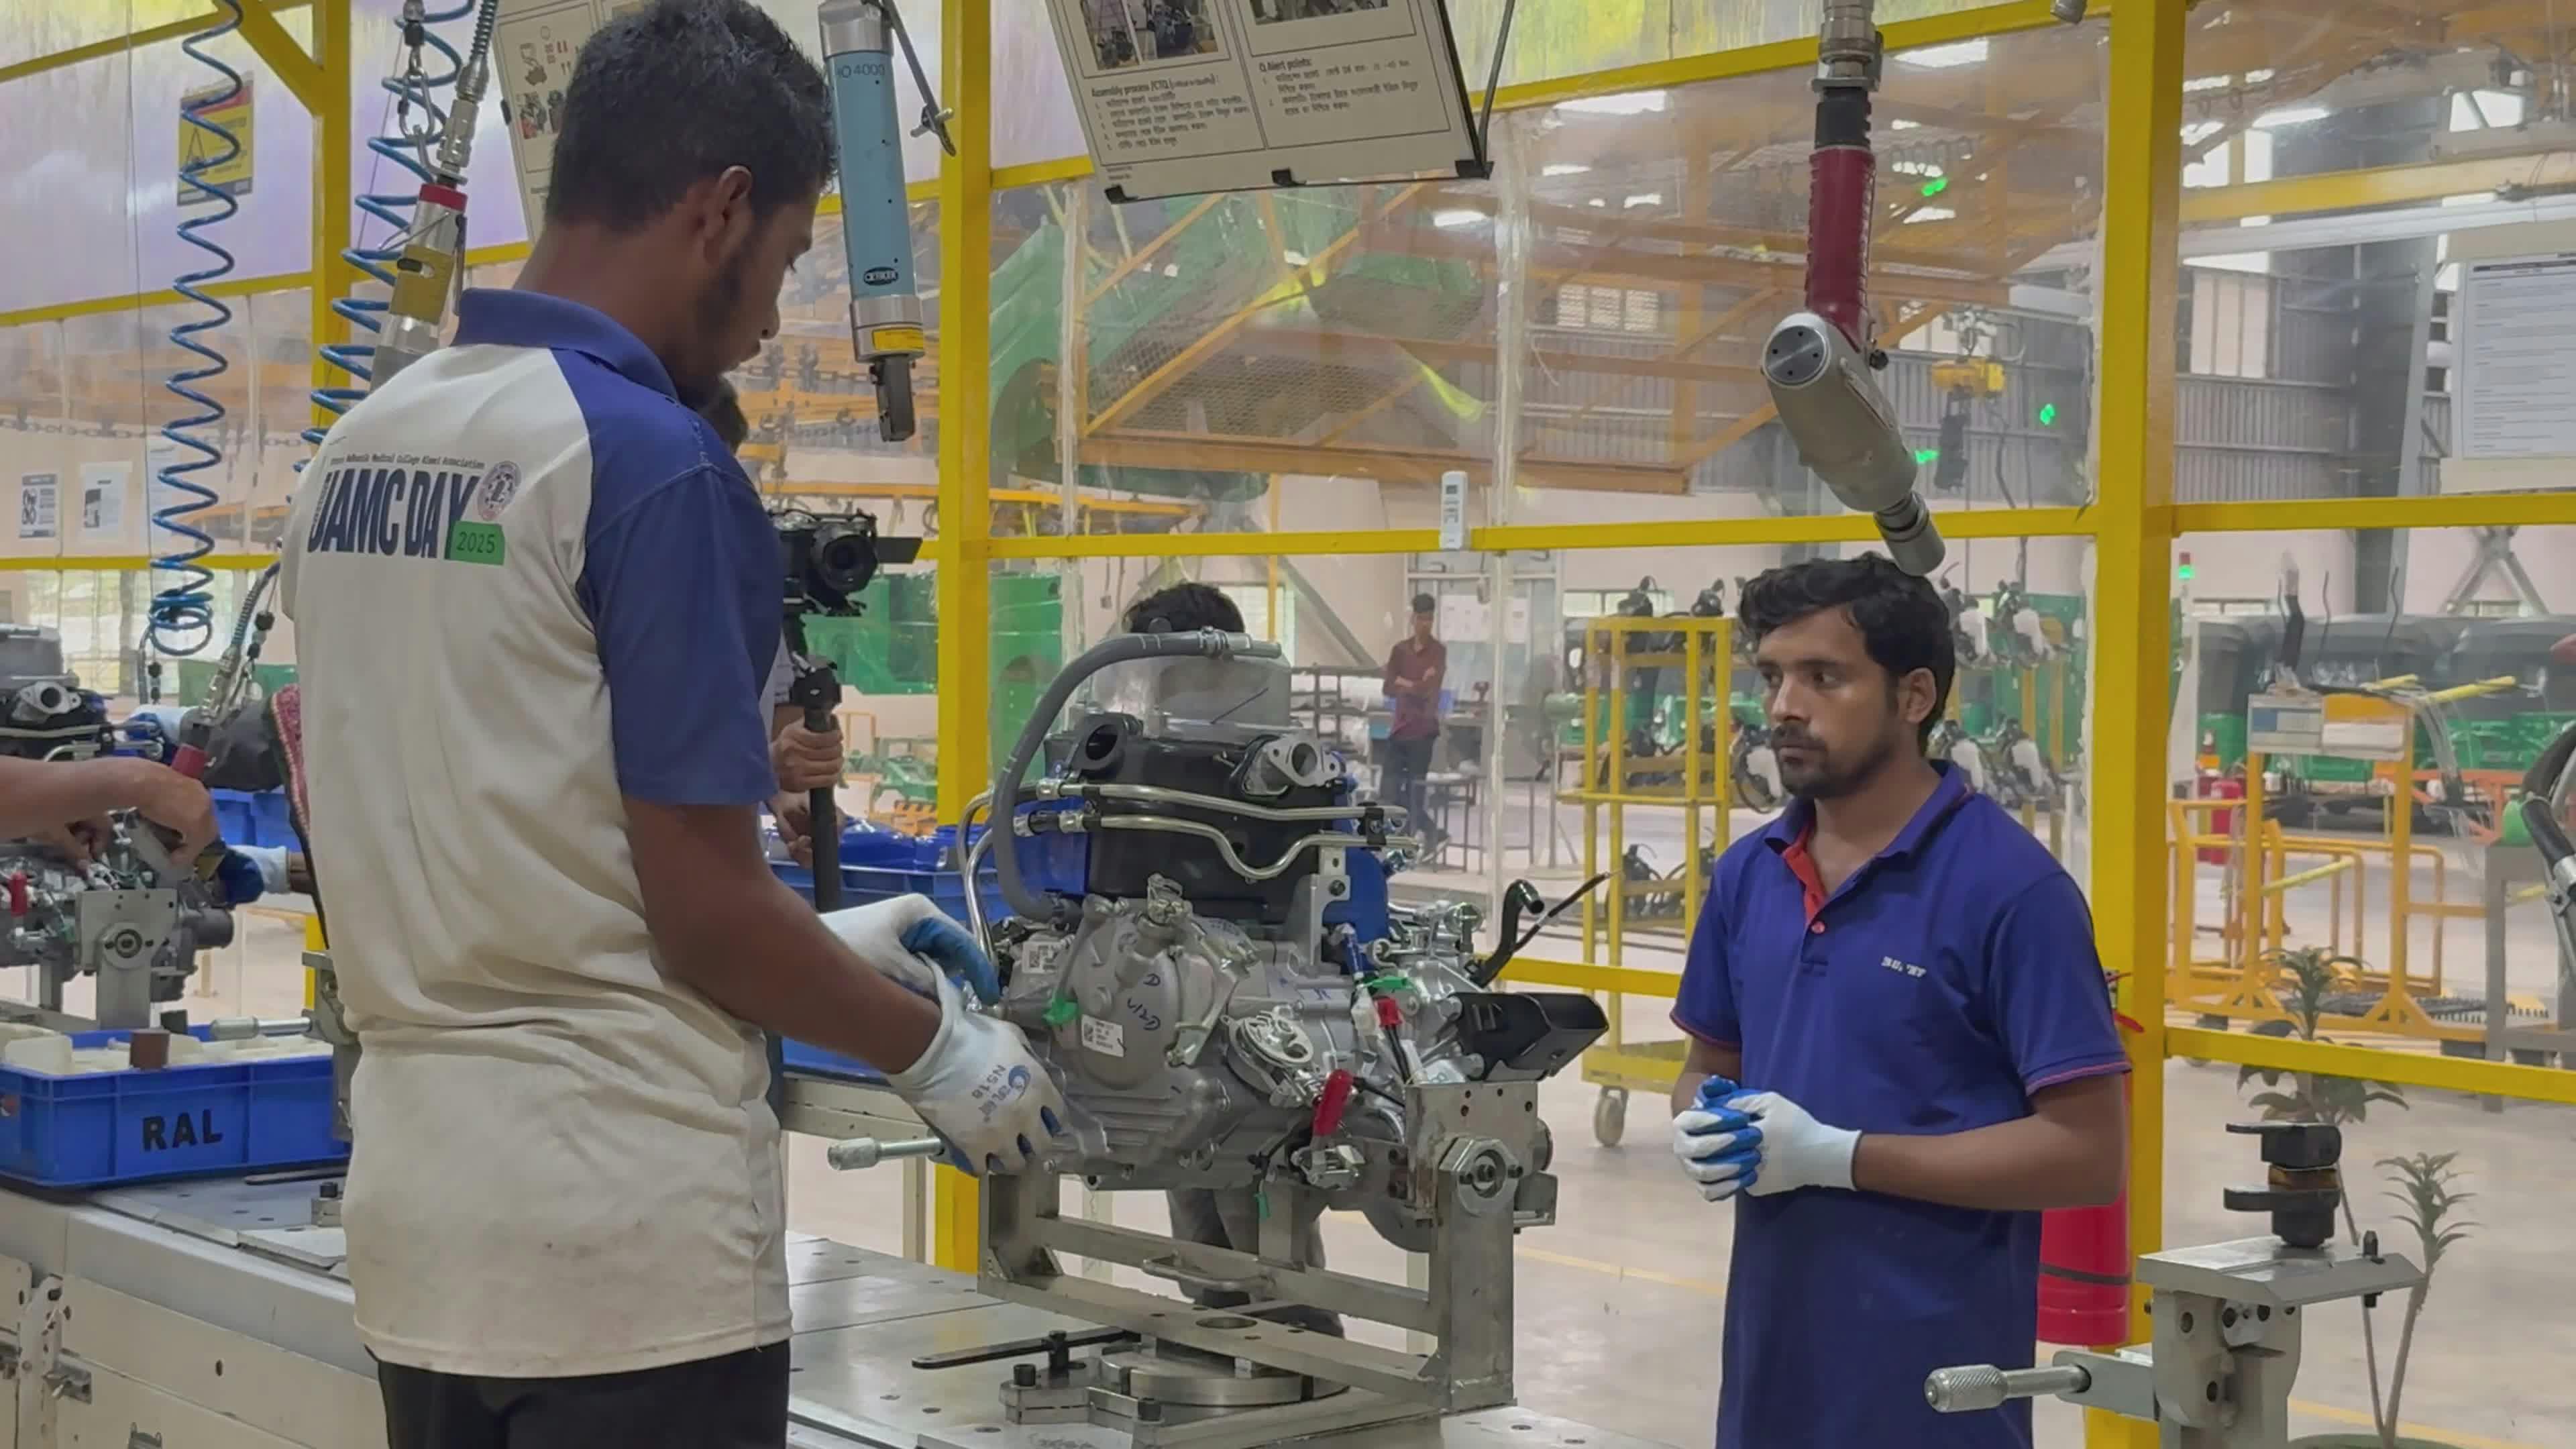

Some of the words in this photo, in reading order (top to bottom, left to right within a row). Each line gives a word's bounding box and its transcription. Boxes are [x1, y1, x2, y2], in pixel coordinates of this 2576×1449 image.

[405, 470, 482, 560] DAY
[456, 531, 496, 554] 2025
[142, 1109, 225, 1152] RAL
